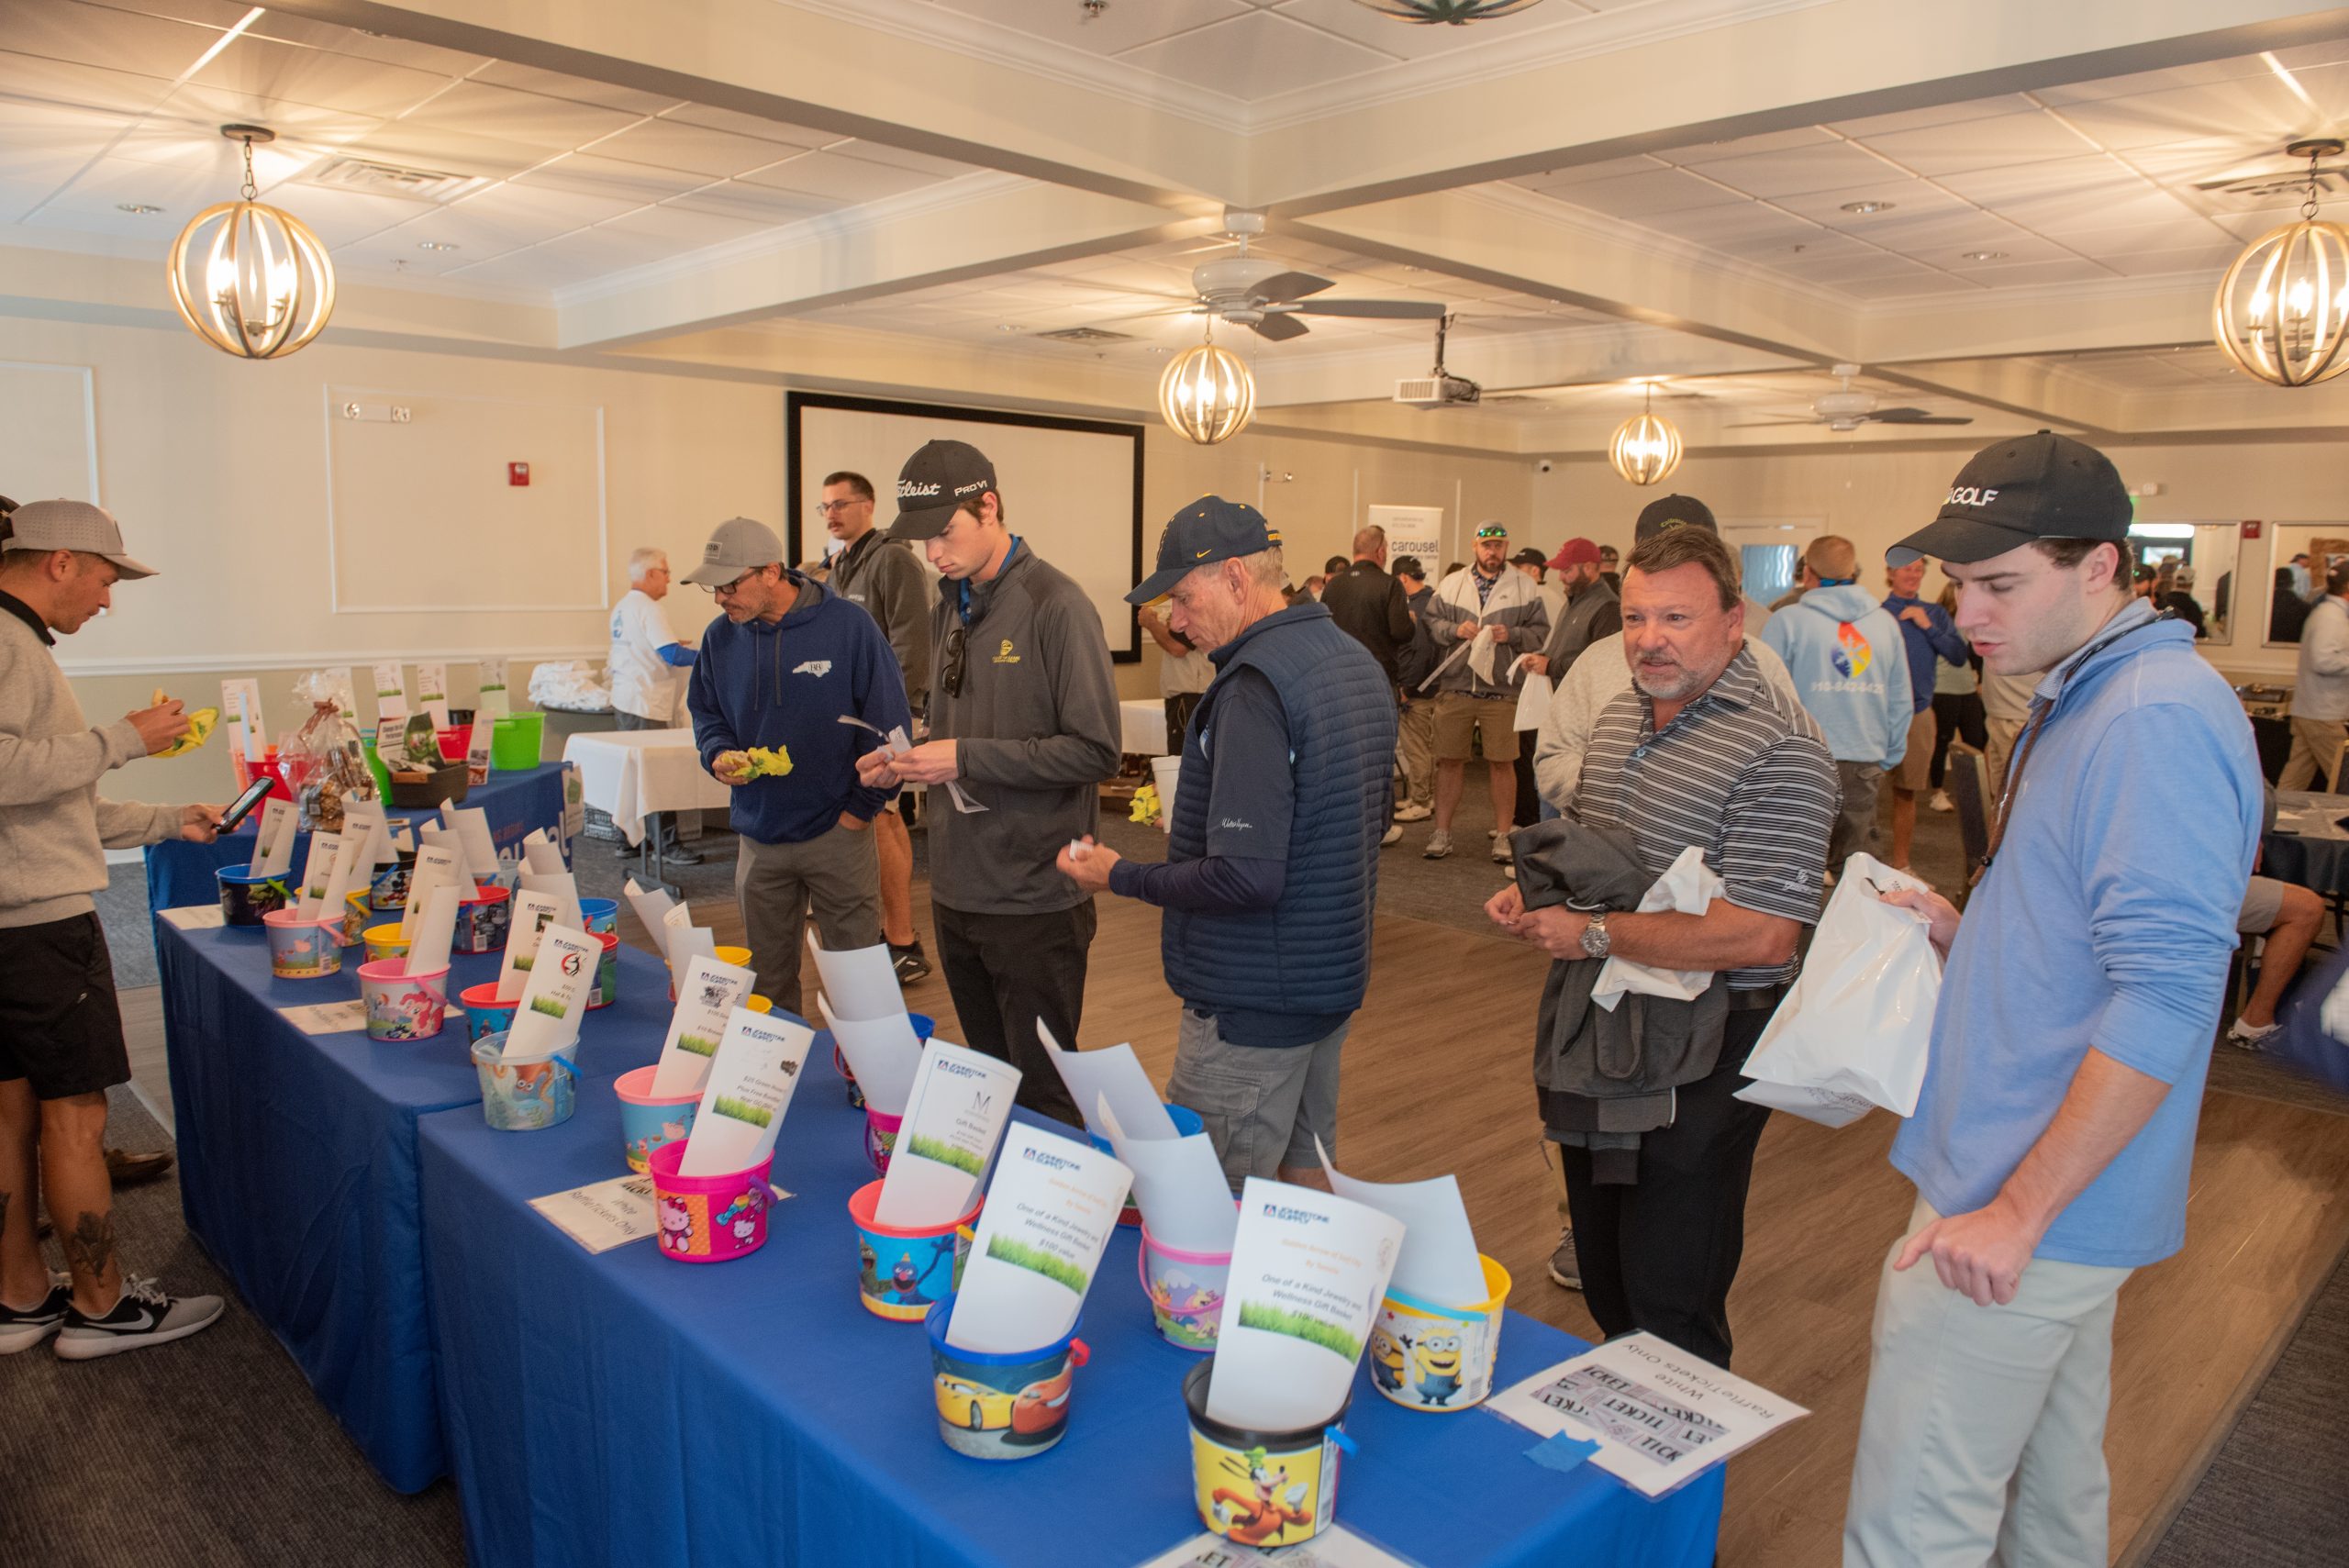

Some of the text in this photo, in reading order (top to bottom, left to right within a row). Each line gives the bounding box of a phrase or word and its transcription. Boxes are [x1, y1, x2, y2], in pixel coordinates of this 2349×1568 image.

[1951, 486, 1999, 506] GOLF
[1391, 539, 1439, 553] carousel
[971, 1091, 992, 1115] M
[1017, 1202, 1034, 1214] One
[1034, 1207, 1045, 1218] of
[1052, 1216, 1071, 1229] Kind
[1024, 1218, 1061, 1237] Wellness
[1060, 1231, 1074, 1242] Gift
[1039, 1239, 1059, 1251] $100
[1262, 1273, 1282, 1284] One
[1282, 1278, 1294, 1287] of
[1294, 1281, 1301, 1289] a
[1301, 1282, 1323, 1296] Kind
[1322, 1287, 1352, 1307] Jewelry
[1272, 1290, 1353, 1321] Wellness Gift Basket
[1622, 1342, 1660, 1363] Only
[1654, 1372, 1705, 1402] White
[1604, 1397, 1664, 1430] TICKET
